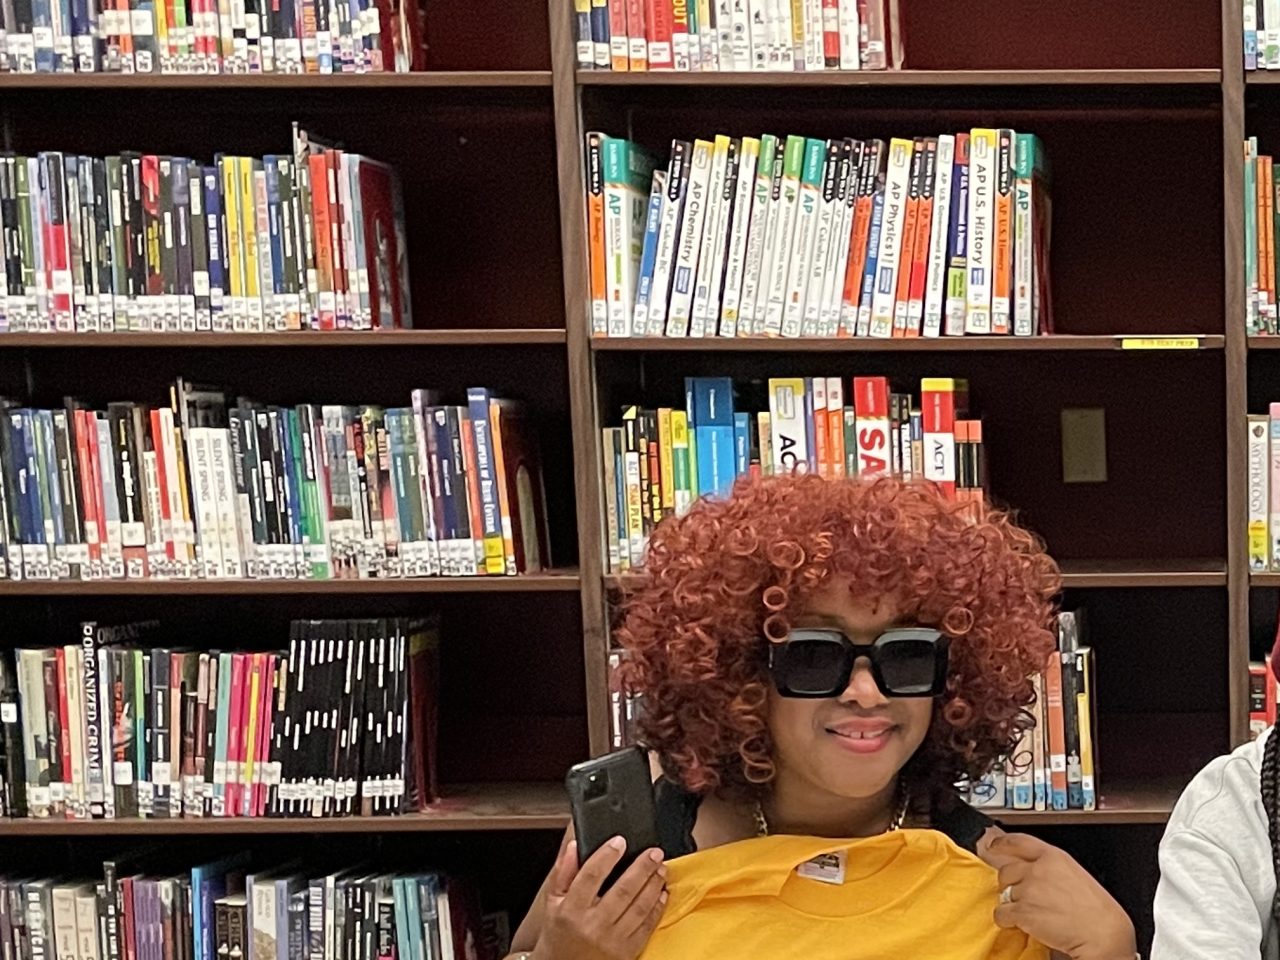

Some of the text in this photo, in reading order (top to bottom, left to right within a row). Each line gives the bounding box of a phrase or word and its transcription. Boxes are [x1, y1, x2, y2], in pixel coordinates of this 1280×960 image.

[608, 194, 621, 215] AP
[756, 184, 768, 204] AP
[802, 194, 814, 214] AP
[891, 181, 901, 200] AP
[972, 163, 987, 264] AP U.S. History
[1018, 189, 1029, 210] AP
[681, 181, 703, 262] AP Chemistry
[884, 204, 899, 249] Physics
[195, 438, 210, 502] SILENT SPRING
[213, 438, 227, 502] SILENT SPRING
[229, 417, 245, 487] Greenhouse
[934, 440, 944, 475] ACT
[1251, 442, 1265, 514] MYTHOLOGY
[83, 637, 98, 721] ORGANIZED
